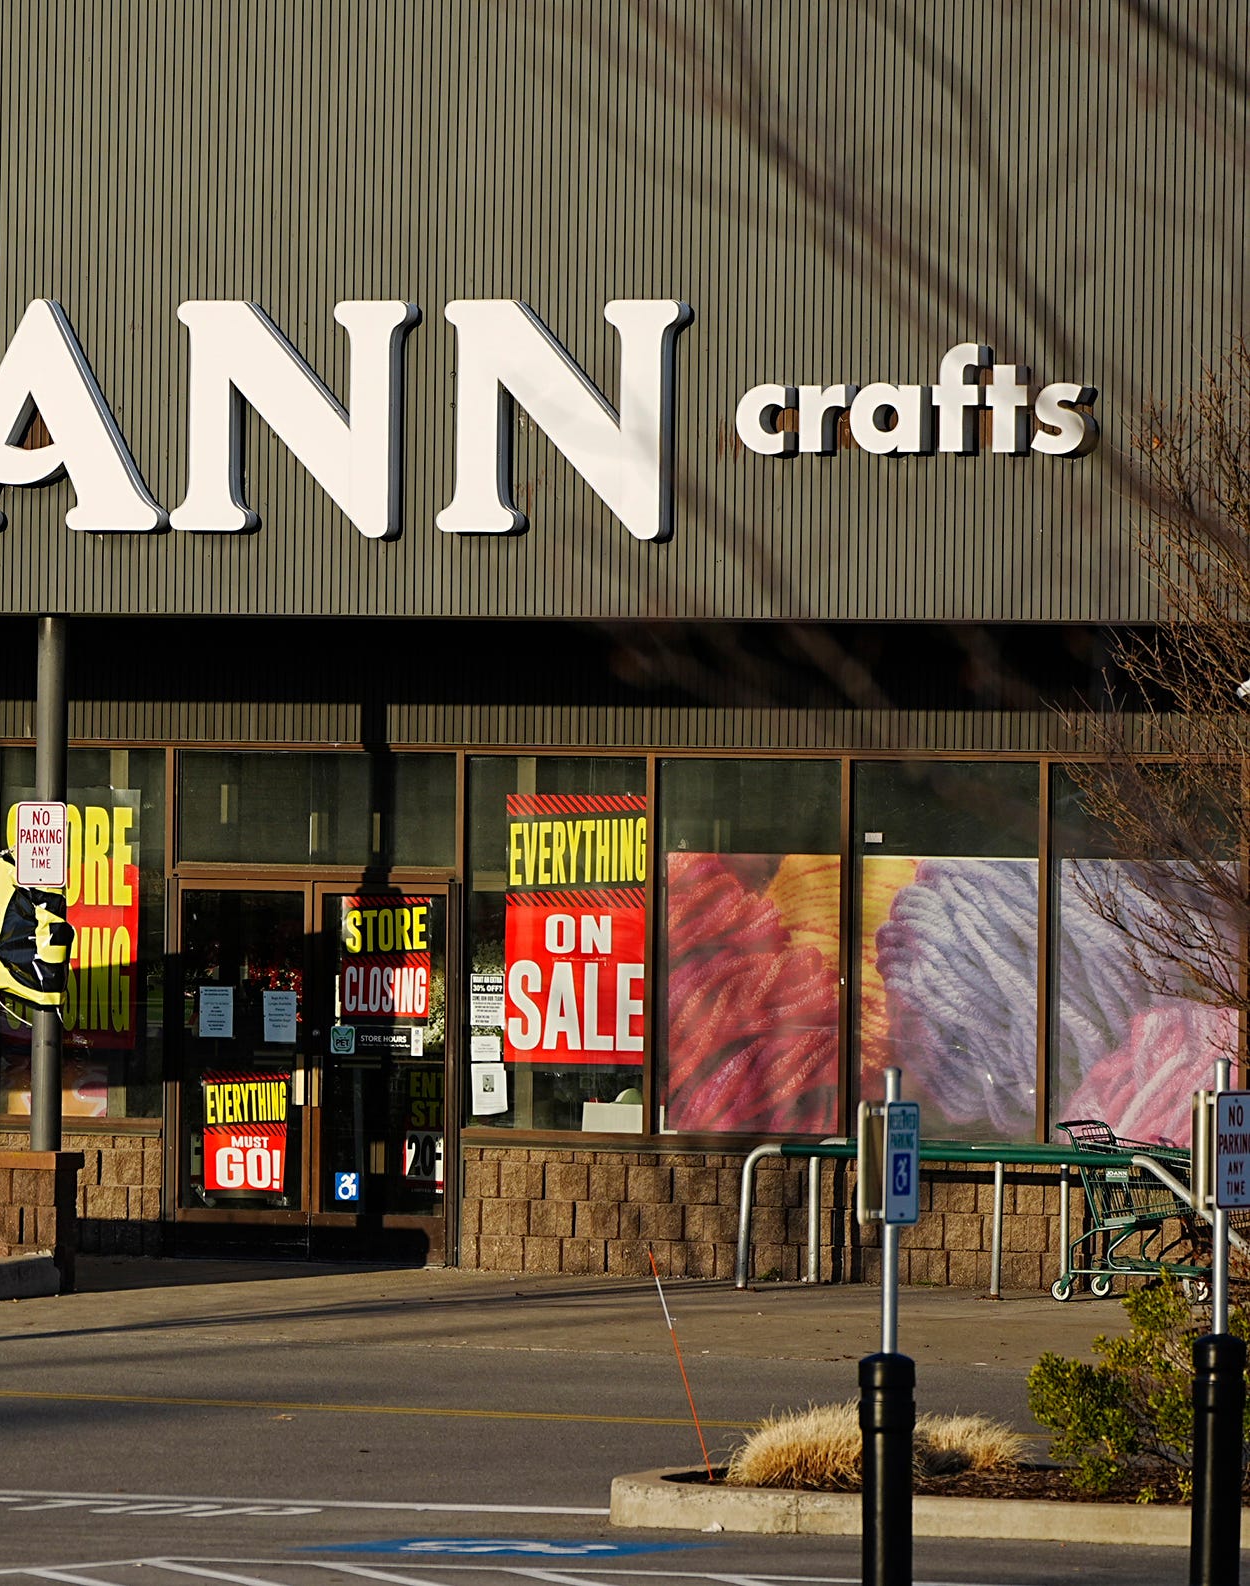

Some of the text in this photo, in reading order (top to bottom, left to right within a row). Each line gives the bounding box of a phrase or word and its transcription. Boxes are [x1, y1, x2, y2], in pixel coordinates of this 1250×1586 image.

[735, 342, 1097, 457] crafts
[32, 810, 50, 826] NO
[20, 829, 62, 845] PARKING
[32, 846, 50, 857] ANY
[509, 816, 646, 886] EVERYTHING
[31, 858, 51, 869] TIME
[345, 906, 427, 953] STORE
[544, 913, 612, 955] ON
[344, 966, 427, 1014] CLOSING
[472, 984, 502, 992] 30% OFF?
[507, 959, 644, 1051] SALE
[335, 1038, 350, 1047] PET
[360, 1034, 407, 1044] STORE HOURS
[206, 1081, 287, 1124] EVERYTHING
[1228, 1105, 1244, 1127] NO
[230, 1135, 269, 1149] MUST
[1218, 1133, 1250, 1155] PARKIN
[215, 1147, 281, 1189] GO!
[1228, 1160, 1244, 1176] ANY
[1226, 1181, 1246, 1196] TIME
